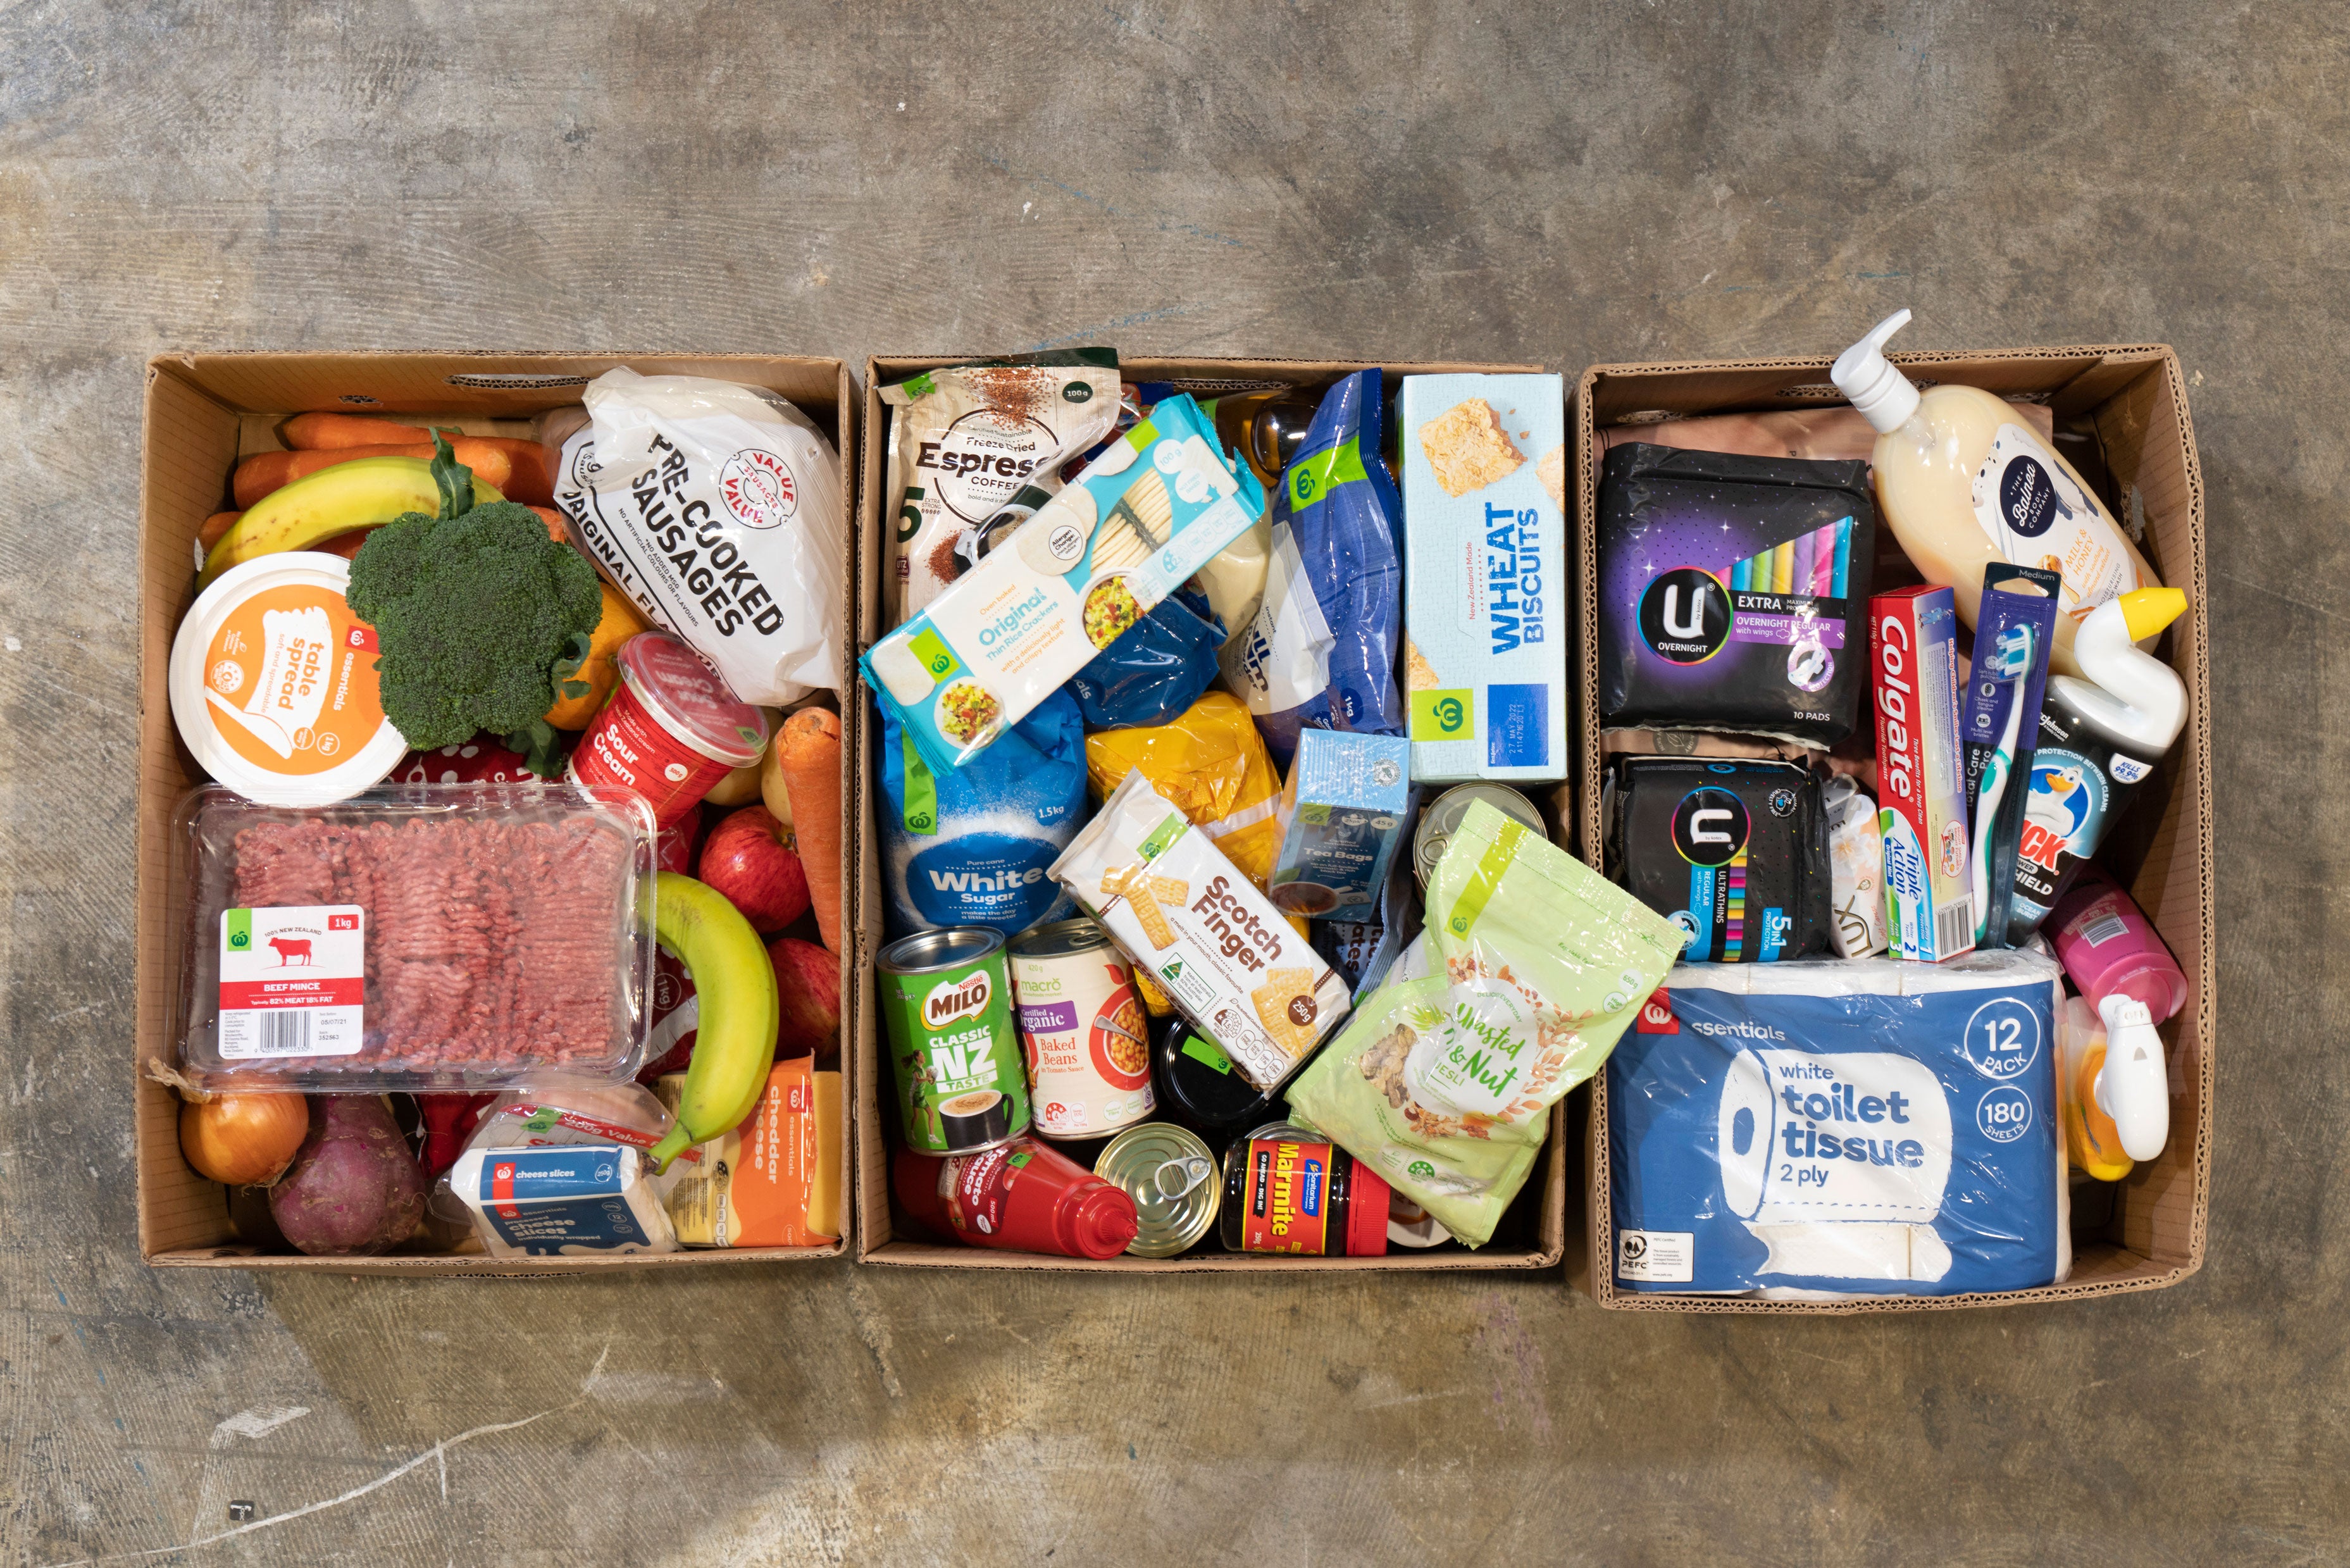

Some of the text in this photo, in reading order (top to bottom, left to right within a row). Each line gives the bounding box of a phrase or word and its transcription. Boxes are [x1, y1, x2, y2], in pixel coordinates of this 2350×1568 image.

[753, 452, 793, 502] VALUE
[971, 476, 1020, 490] COFFEE
[725, 478, 764, 524] VALUE
[2012, 463, 2036, 527] Balnea
[2029, 491, 2042, 515] BODY
[2029, 487, 2051, 529] COMPANY
[897, 487, 925, 544] 5
[647, 433, 784, 636] PRE-COOKED
[1052, 529, 1072, 547] Allergen
[631, 468, 744, 637] SAUSAGES
[2065, 528, 2088, 569] MILK &
[2073, 536, 2095, 576] HONEY
[618, 507, 699, 627] NO ARTIFICIAL COLOURS OR FLAVOURS
[1484, 501, 1520, 656] WHEAT
[1517, 508, 1545, 644] BISCUITS
[2019, 569, 2055, 582] Medium
[2081, 544, 2104, 590] with soothing
[2087, 549, 2111, 598] almond extract
[2098, 563, 2120, 607] MOISTURISING
[979, 584, 1016, 616] Oven baked
[1738, 595, 1782, 610] EXTRA
[979, 587, 1048, 646] Original
[1265, 606, 1277, 633] Instant
[1736, 616, 1831, 632] OVERNIGHT REGULAR
[986, 600, 1059, 661] Thin Rice Crackers
[1753, 628, 1773, 637] wings
[1658, 642, 1708, 653] OVERNIGHT
[278, 637, 305, 710] spread
[298, 642, 325, 696] table
[333, 652, 354, 711] essentials
[1793, 711, 1831, 721] 10 PADS
[1878, 616, 1913, 798] Colgate
[606, 724, 639, 764] Sour
[1508, 744, 1516, 754] 27
[594, 733, 635, 786] Cream
[1967, 749, 1980, 775] Care
[1979, 750, 1991, 770] Pro
[2113, 766, 2139, 780] 99.9%
[2120, 762, 2142, 773] KILLS
[2037, 748, 2109, 813] PROTECTION BETWEEN CLEANS
[1303, 847, 1374, 862] Tea Bags
[1893, 837, 1906, 895] Action
[928, 867, 1043, 892] White
[1906, 852, 1922, 900] Triple
[2014, 869, 2053, 895] HIELD
[961, 892, 1016, 905] Sugar
[1717, 871, 1726, 923] ULTRATHINS
[2019, 902, 2042, 916] OCEAN
[1206, 875, 1282, 961] Scotch
[1834, 895, 1873, 957] LUX
[2017, 908, 2038, 921] BURST
[295, 927, 322, 936] ZEALAND
[1191, 893, 1265, 973] Finger
[1889, 940, 1901, 952] 3
[1905, 942, 1917, 952] 2
[264, 983, 320, 992] BEEF MINCE
[1021, 978, 1061, 993] macro
[931, 983, 986, 1019] MILO
[1292, 1000, 1311, 1023] 250g
[929, 1025, 991, 1048] CLASSIC
[1040, 1037, 1076, 1051] Baked
[1692, 1022, 1786, 1042] ssentials
[1984, 1018, 2022, 1052] 12
[931, 1036, 997, 1082] NZ
[1043, 1053, 1078, 1066] Beans
[1779, 1062, 1834, 1080] white
[1982, 1054, 2028, 1074] PACK
[947, 1074, 990, 1091] TASTE
[1462, 1049, 1519, 1098] Nut
[1780, 1083, 1910, 1124] toilet
[1984, 1102, 2025, 1123] 180
[608, 1129, 647, 1145] Value
[768, 1085, 781, 1184] cheddar
[1781, 1121, 1925, 1168] tissue
[1984, 1123, 2023, 1139] SHEETS
[516, 1169, 575, 1179] cheese slices
[972, 1148, 1008, 1206] Tomato
[1780, 1164, 1830, 1188] 2 ply
[1272, 1143, 1300, 1236] Marmite
[1309, 1173, 1321, 1210] Sanitarium
[509, 1218, 576, 1231] cheese
[514, 1227, 568, 1237] slices
[1622, 1260, 1646, 1269] PEFC
